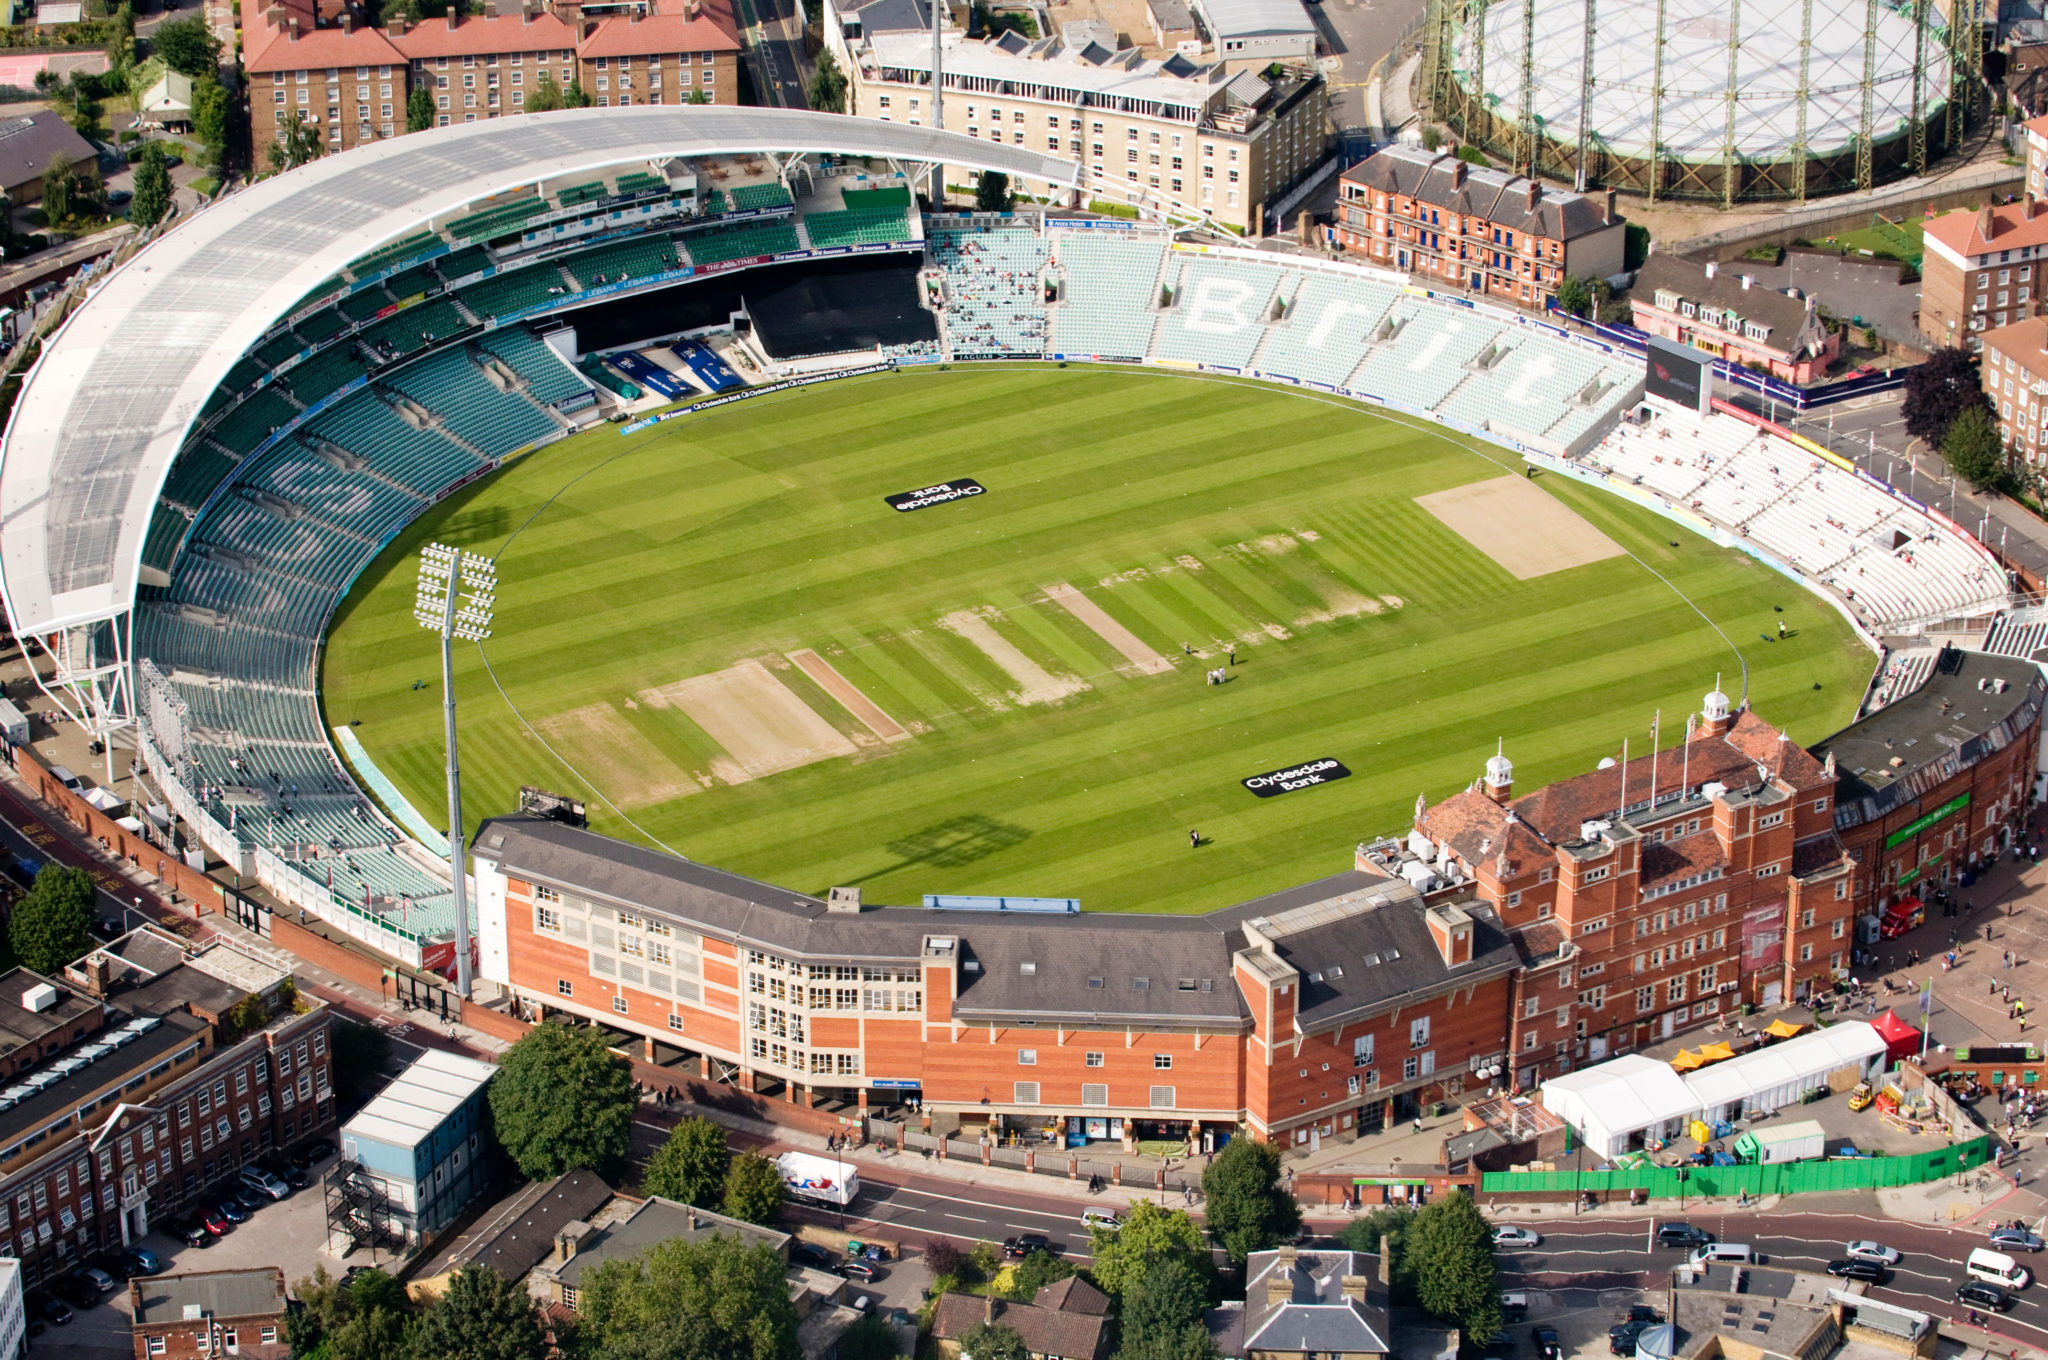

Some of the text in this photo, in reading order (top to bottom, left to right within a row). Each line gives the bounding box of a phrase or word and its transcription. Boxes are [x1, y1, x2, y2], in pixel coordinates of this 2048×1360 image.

[706, 257, 758, 271] THE TIMES
[659, 269, 690, 280] LEBARA
[623, 276, 654, 288] LEBARA
[587, 284, 617, 297] LEBARA
[553, 293, 583, 307] LEBARA
[1184, 276, 1558, 408] Brit
[959, 353, 993, 361] JAGUAR
[848, 366, 876, 377] Clydesdale
[798, 375, 826, 386] Clydesdale
[701, 398, 729, 409] Clydesdale
[624, 417, 653, 434] LEBARA
[896, 485, 983, 511] Clydesdale
[909, 484, 952, 498] Bank
[1246, 760, 1338, 788] Clydesdale
[1279, 774, 1327, 791] Bank
